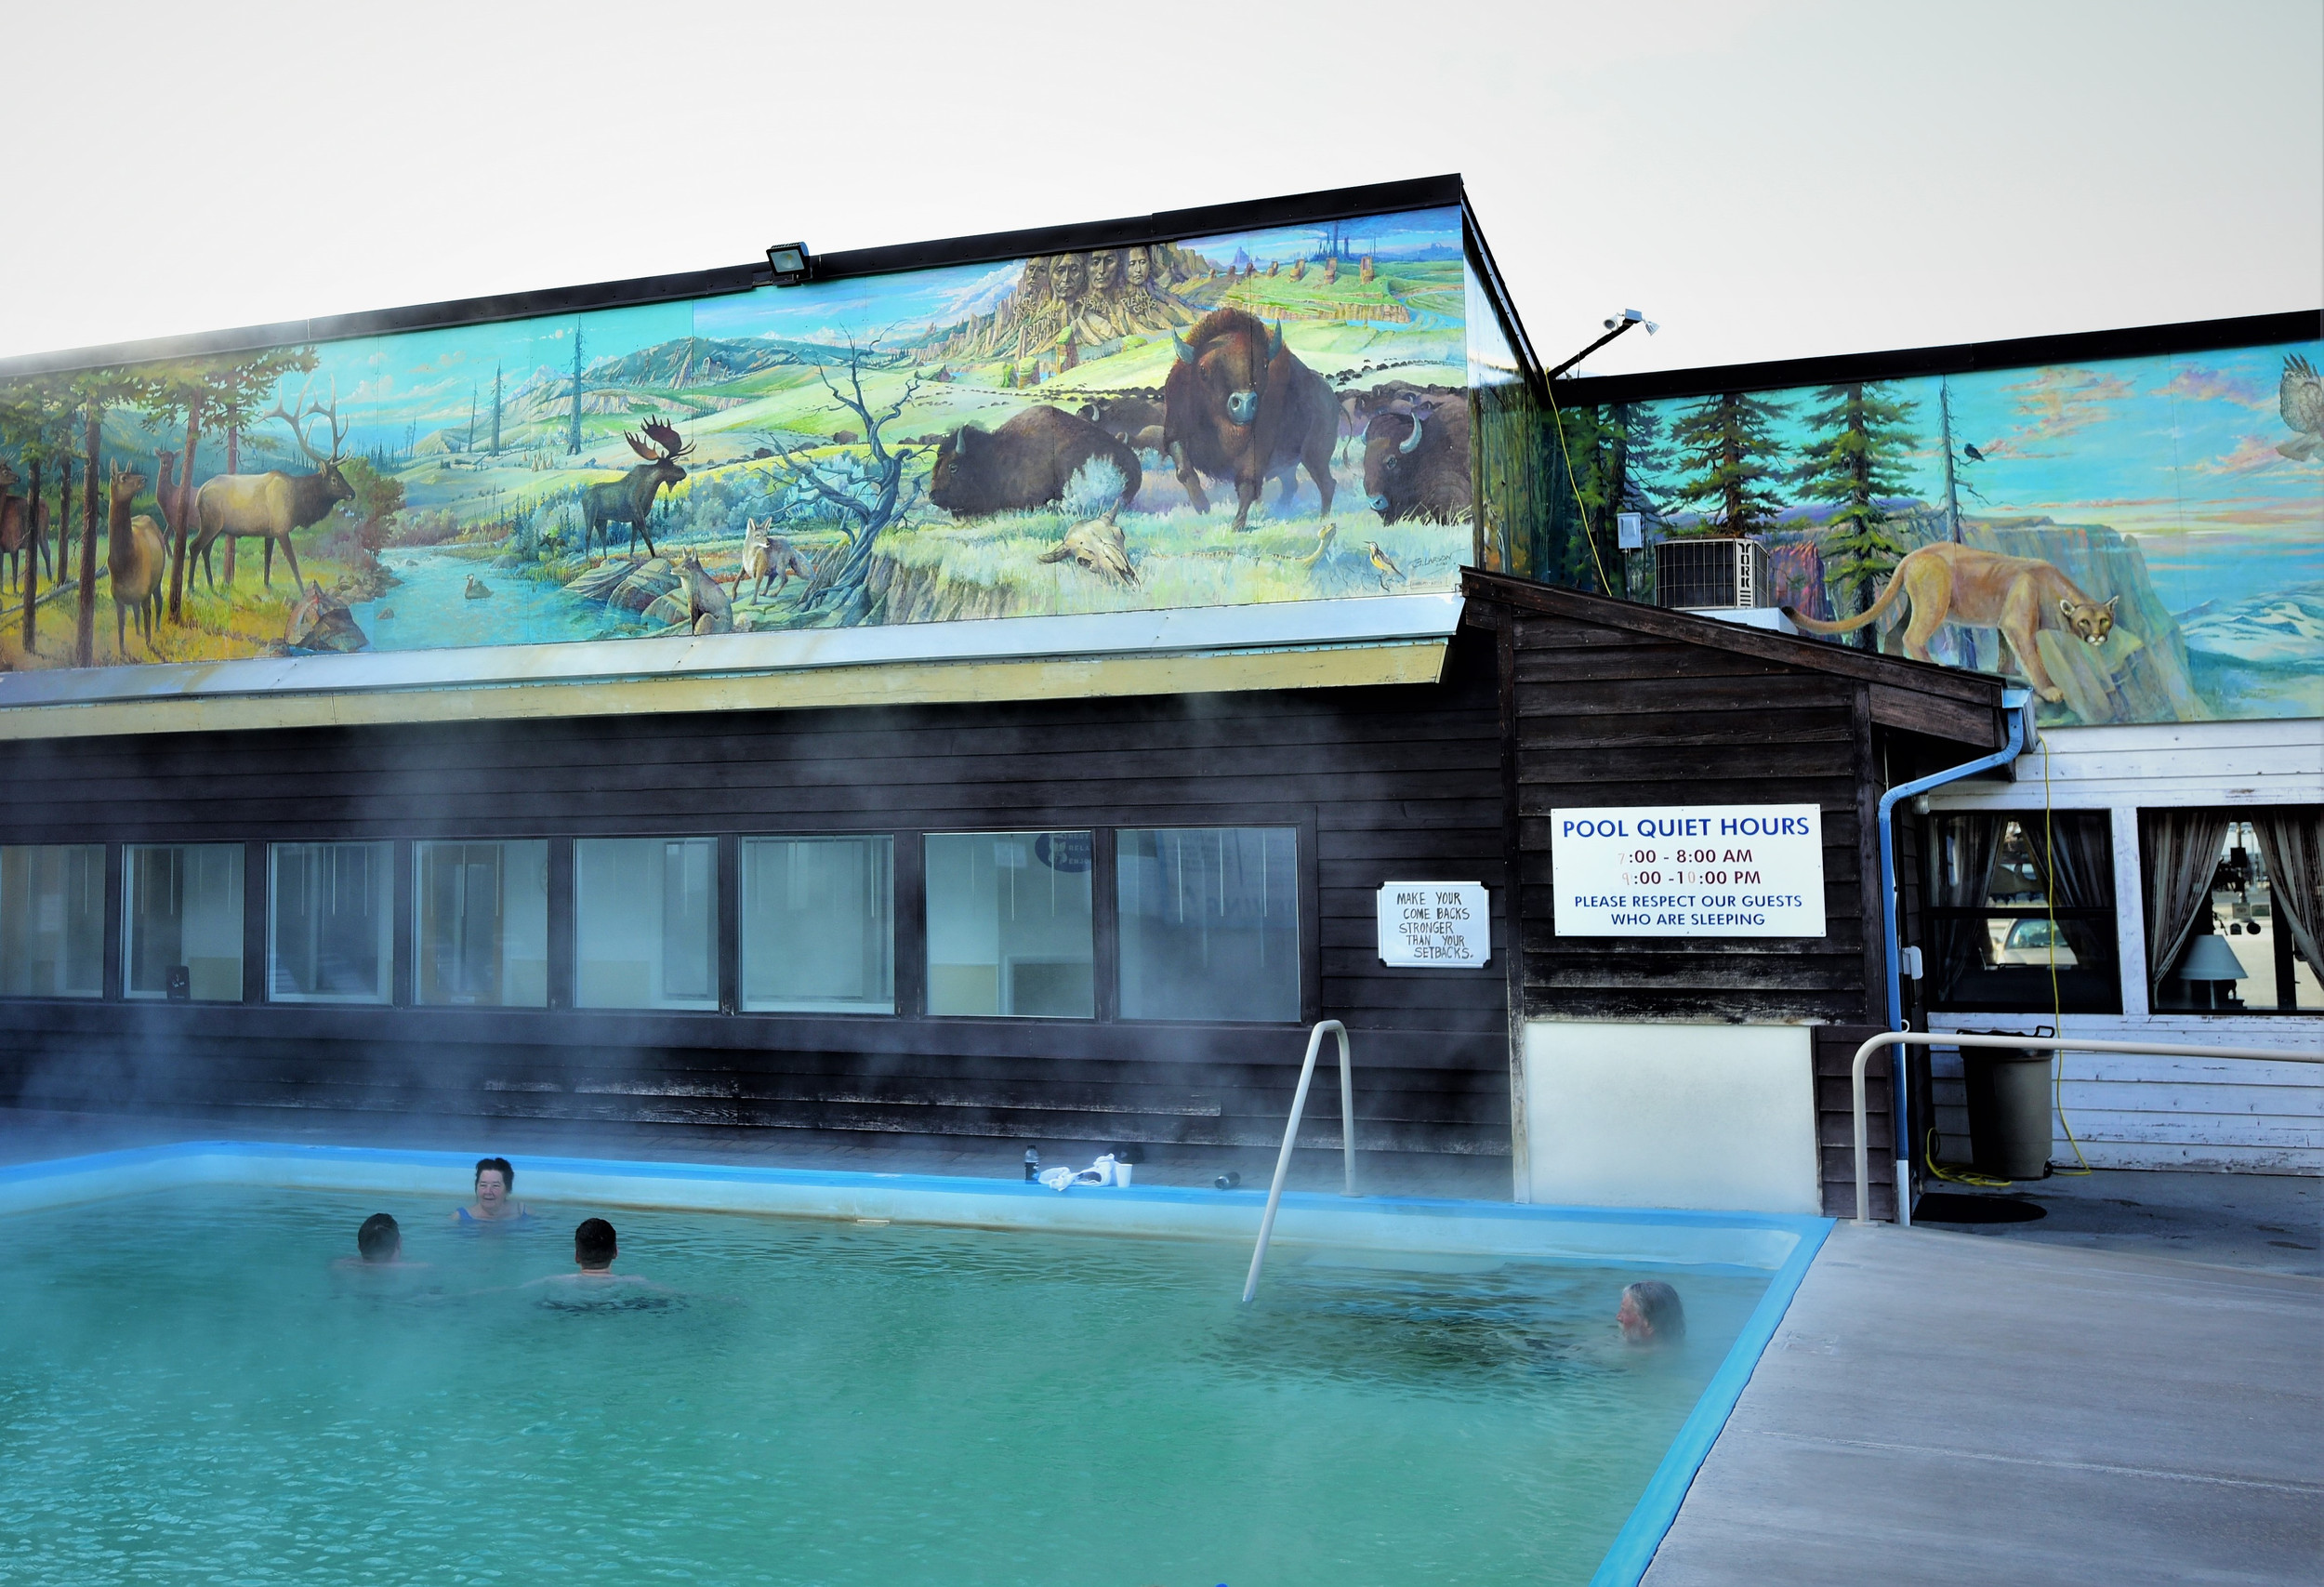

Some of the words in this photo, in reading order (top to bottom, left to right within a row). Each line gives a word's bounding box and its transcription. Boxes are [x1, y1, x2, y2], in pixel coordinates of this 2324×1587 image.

[1737, 543, 1750, 588] YORK
[1563, 820, 1629, 838] POOL
[1637, 819, 1710, 839] QUIET
[1722, 817, 1809, 836] HOURS
[1677, 850, 1716, 863] 8:00
[1723, 850, 1752, 863] AM
[1735, 871, 1761, 884] PM
[1396, 893, 1426, 905] MAKE
[1435, 893, 1461, 906] YOUR
[1575, 896, 1626, 907] PLEASE
[1632, 895, 1696, 907] RESPECT
[1702, 895, 1736, 907] OUR
[1742, 895, 1802, 907] GUESTS
[1404, 908, 1431, 919] COME
[1437, 907, 1470, 920] BACKS
[1611, 914, 1651, 925] WHO
[1657, 914, 1684, 925] ARE
[1691, 914, 1764, 926] SLEEPING
[1399, 922, 1454, 933] STRONGER
[1406, 934, 1432, 946] THAN
[1442, 935, 1465, 946] YOUR
[1414, 946, 1473, 959] SETBACKS.
